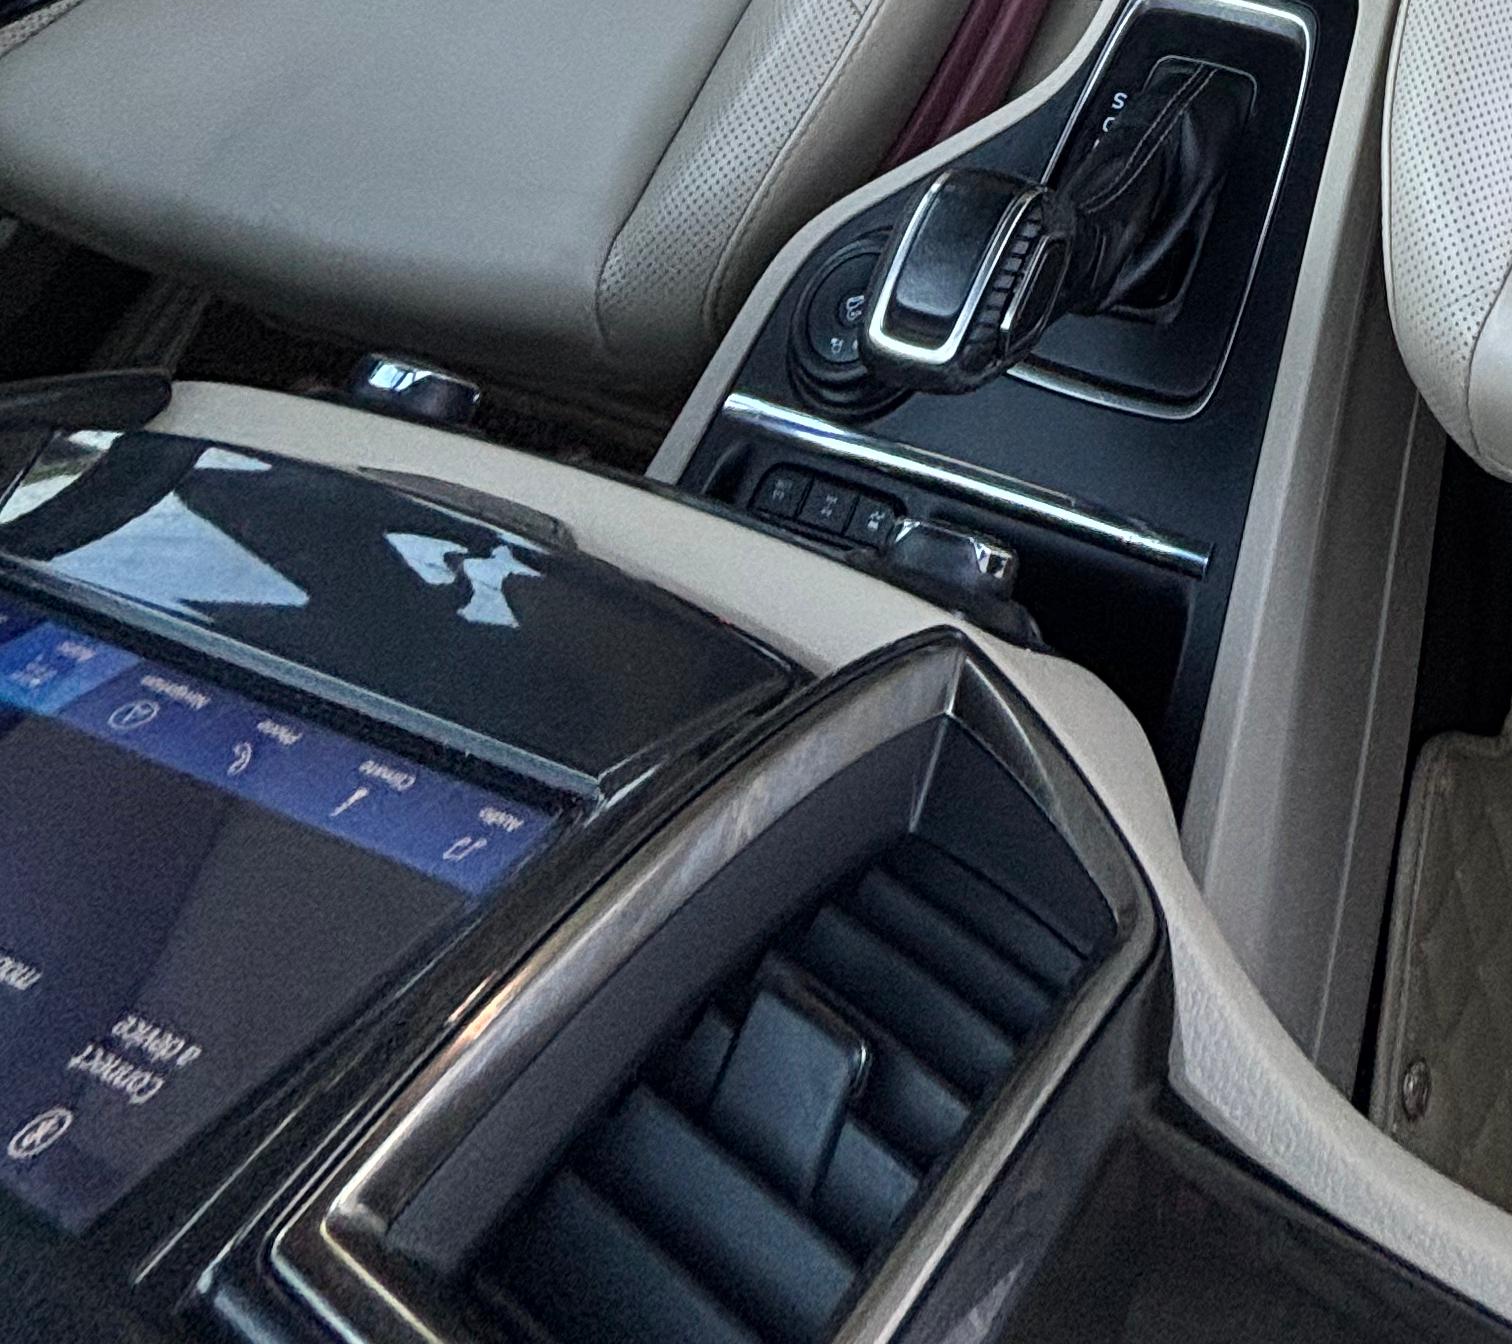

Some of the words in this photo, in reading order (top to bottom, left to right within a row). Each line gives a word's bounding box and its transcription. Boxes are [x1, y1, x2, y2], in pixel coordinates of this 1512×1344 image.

[1111, 92, 1128, 110] S
[359, 760, 416, 791] Climate
[111, 1015, 186, 1063] device
[176, 1044, 202, 1066] a
[67, 1044, 165, 1104] Connect
